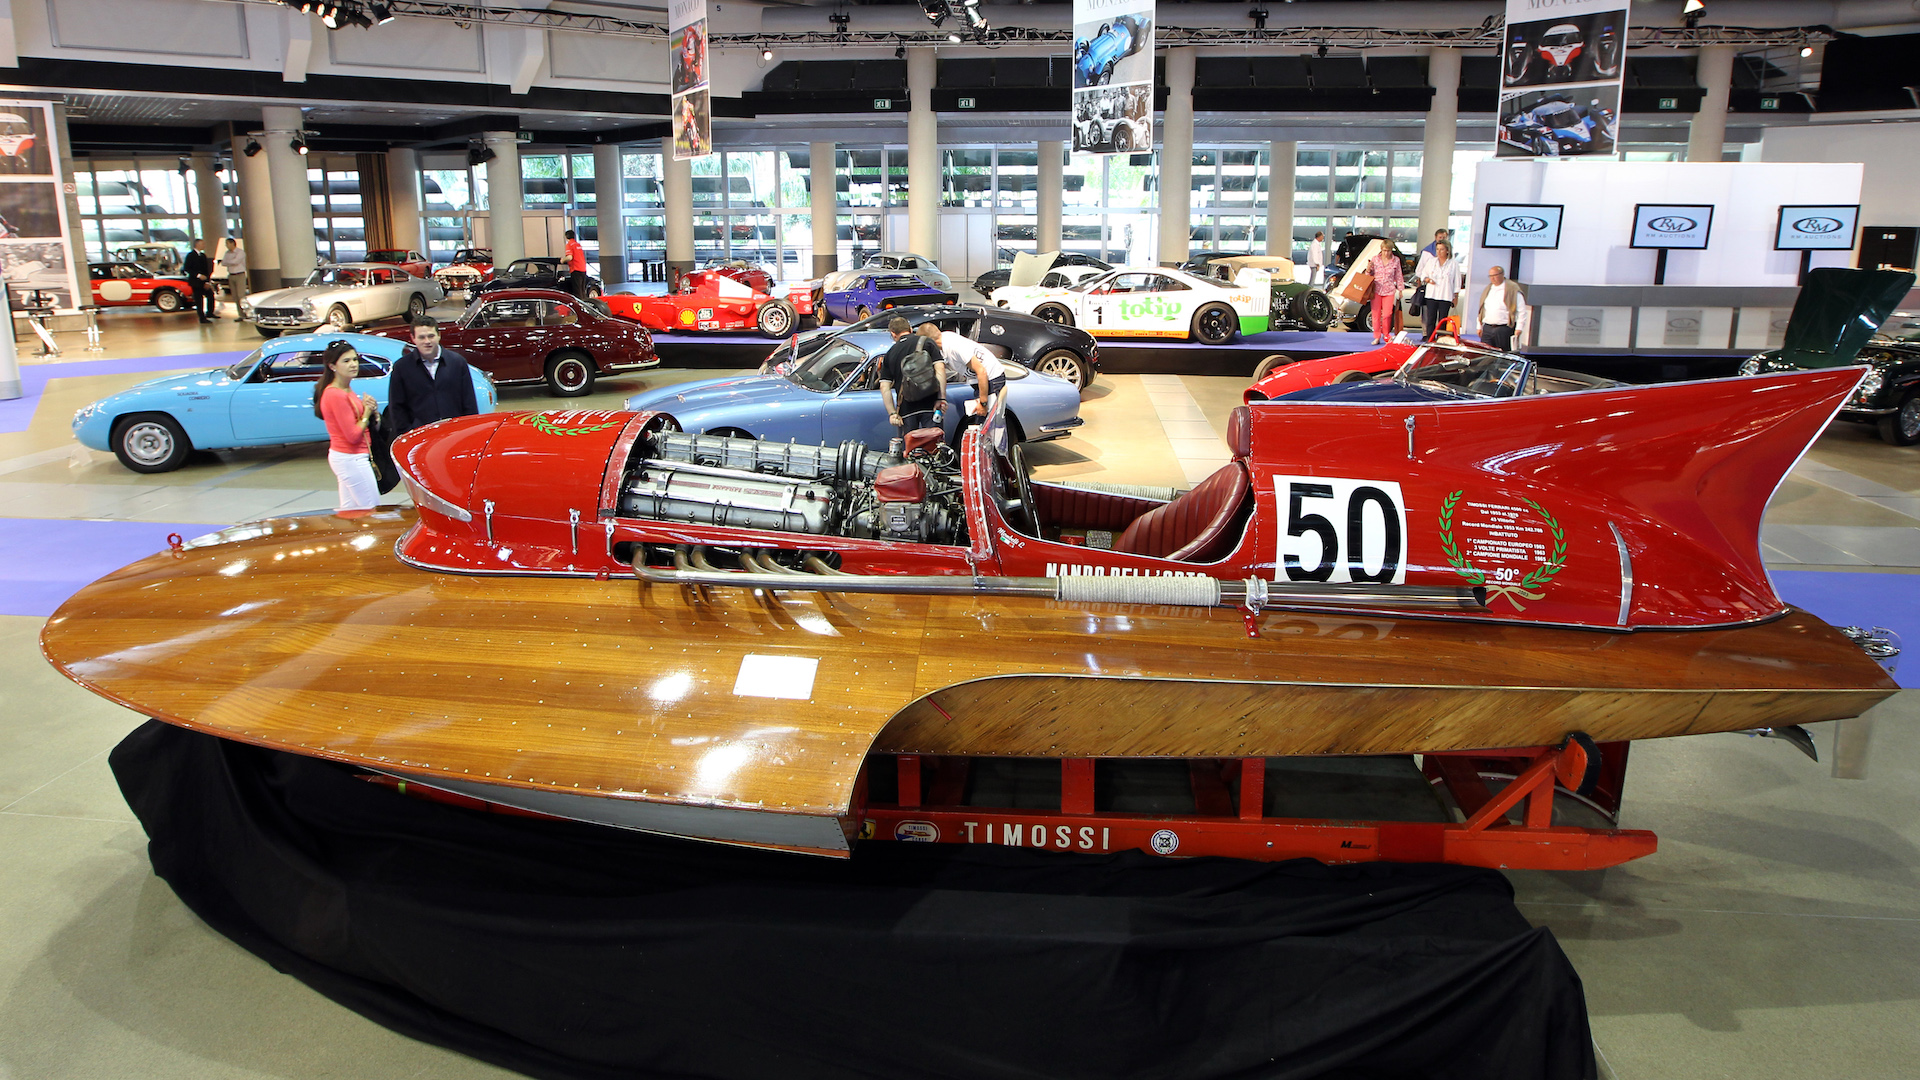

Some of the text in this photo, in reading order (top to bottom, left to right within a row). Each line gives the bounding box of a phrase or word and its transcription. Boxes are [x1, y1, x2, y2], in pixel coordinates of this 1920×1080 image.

[1229, 294, 1252, 304] totip
[1093, 306, 1103, 325] 1
[1118, 297, 1182, 321] totip
[1283, 482, 1402, 583] 50
[1472, 538, 1508, 547] CAMPIONATO
[1508, 541, 1534, 549] EUROPEO
[1496, 546, 1527, 554] PRIMATISTA
[1495, 567, 1520, 581] 50°
[964, 822, 1110, 850] TIMOSSI
